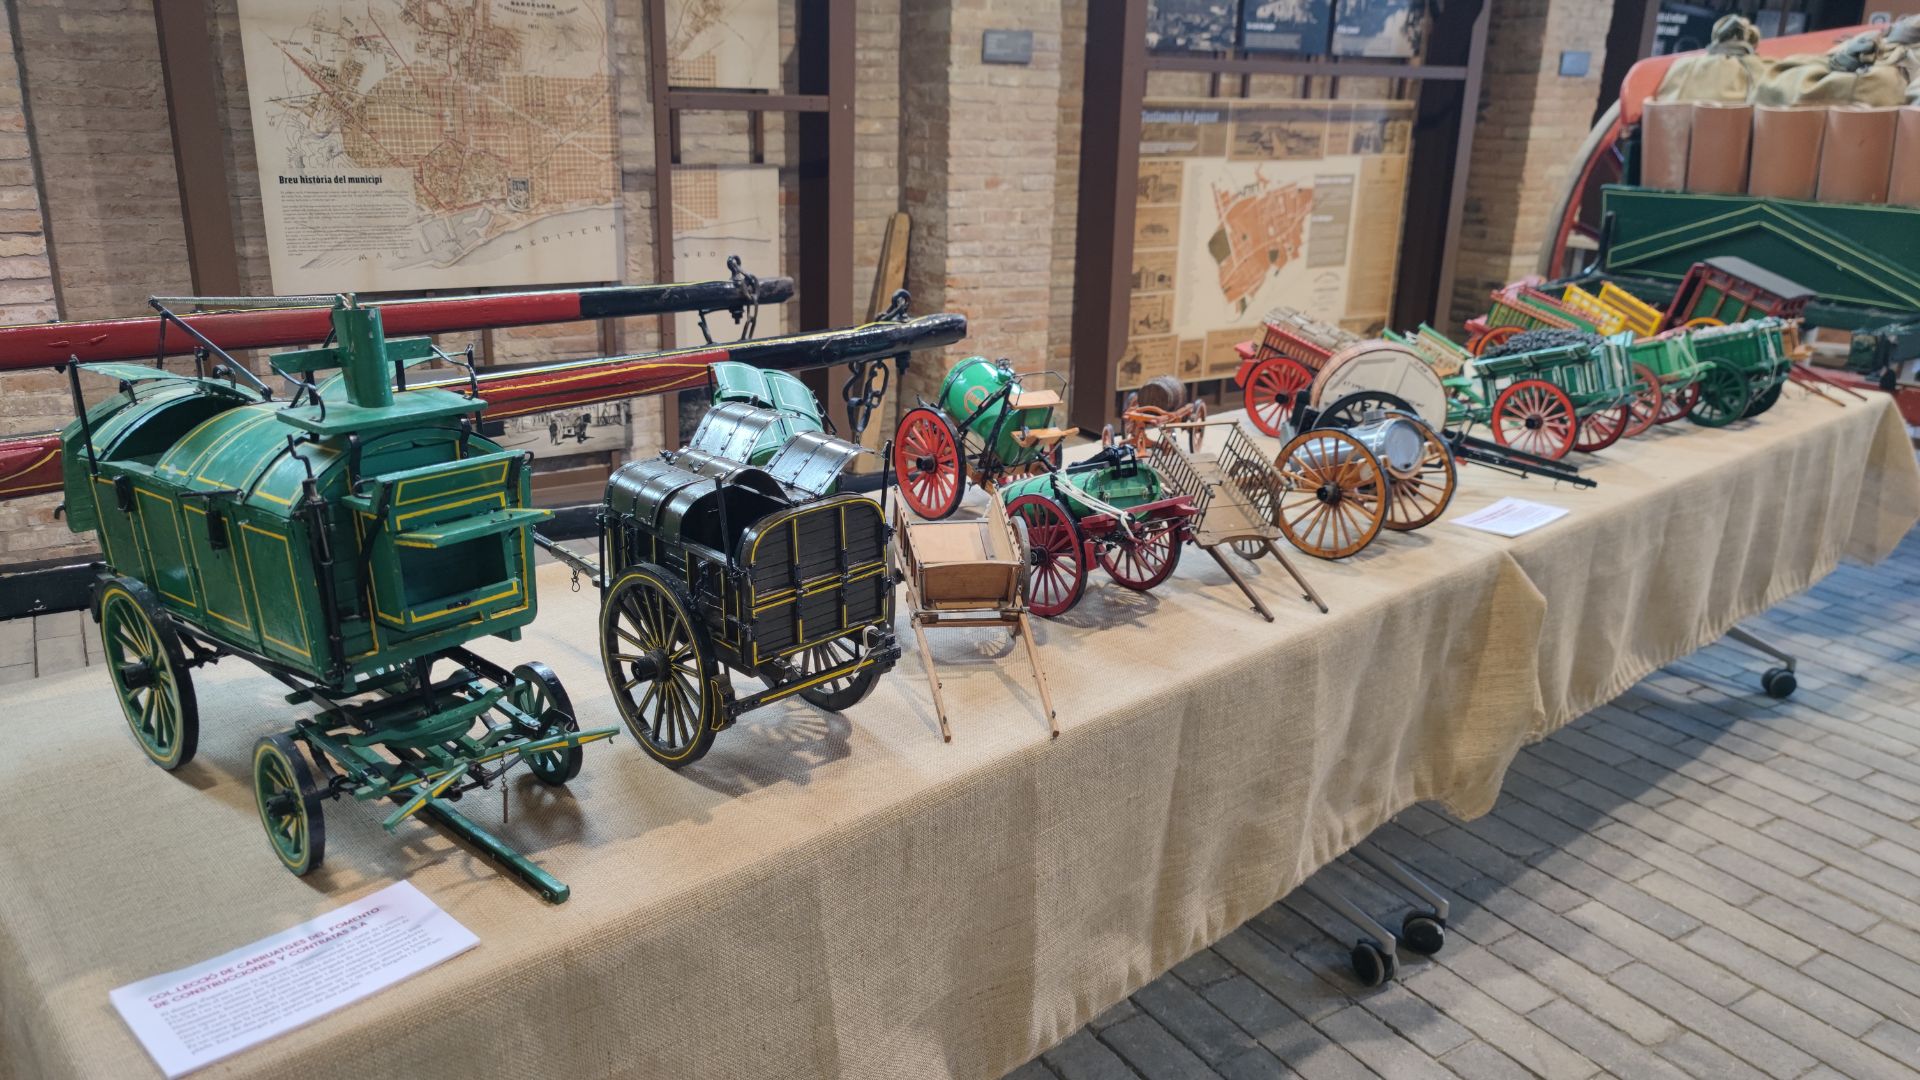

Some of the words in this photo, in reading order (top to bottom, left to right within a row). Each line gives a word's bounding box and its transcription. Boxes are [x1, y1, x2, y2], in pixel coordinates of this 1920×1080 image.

[279, 175, 299, 184] Breu
[300, 175, 332, 184] història
[333, 175, 346, 184] del
[348, 175, 383, 186] municipi
[153, 1000, 169, 1009] DE
[172, 960, 276, 1002] CONSTRUCCIONES
[289, 929, 349, 957] CONTRATAS
[220, 967, 235, 976] DE
[237, 938, 306, 969] CARRUATGES
[308, 930, 328, 941] DEL
[329, 907, 380, 932] FOMENTO
